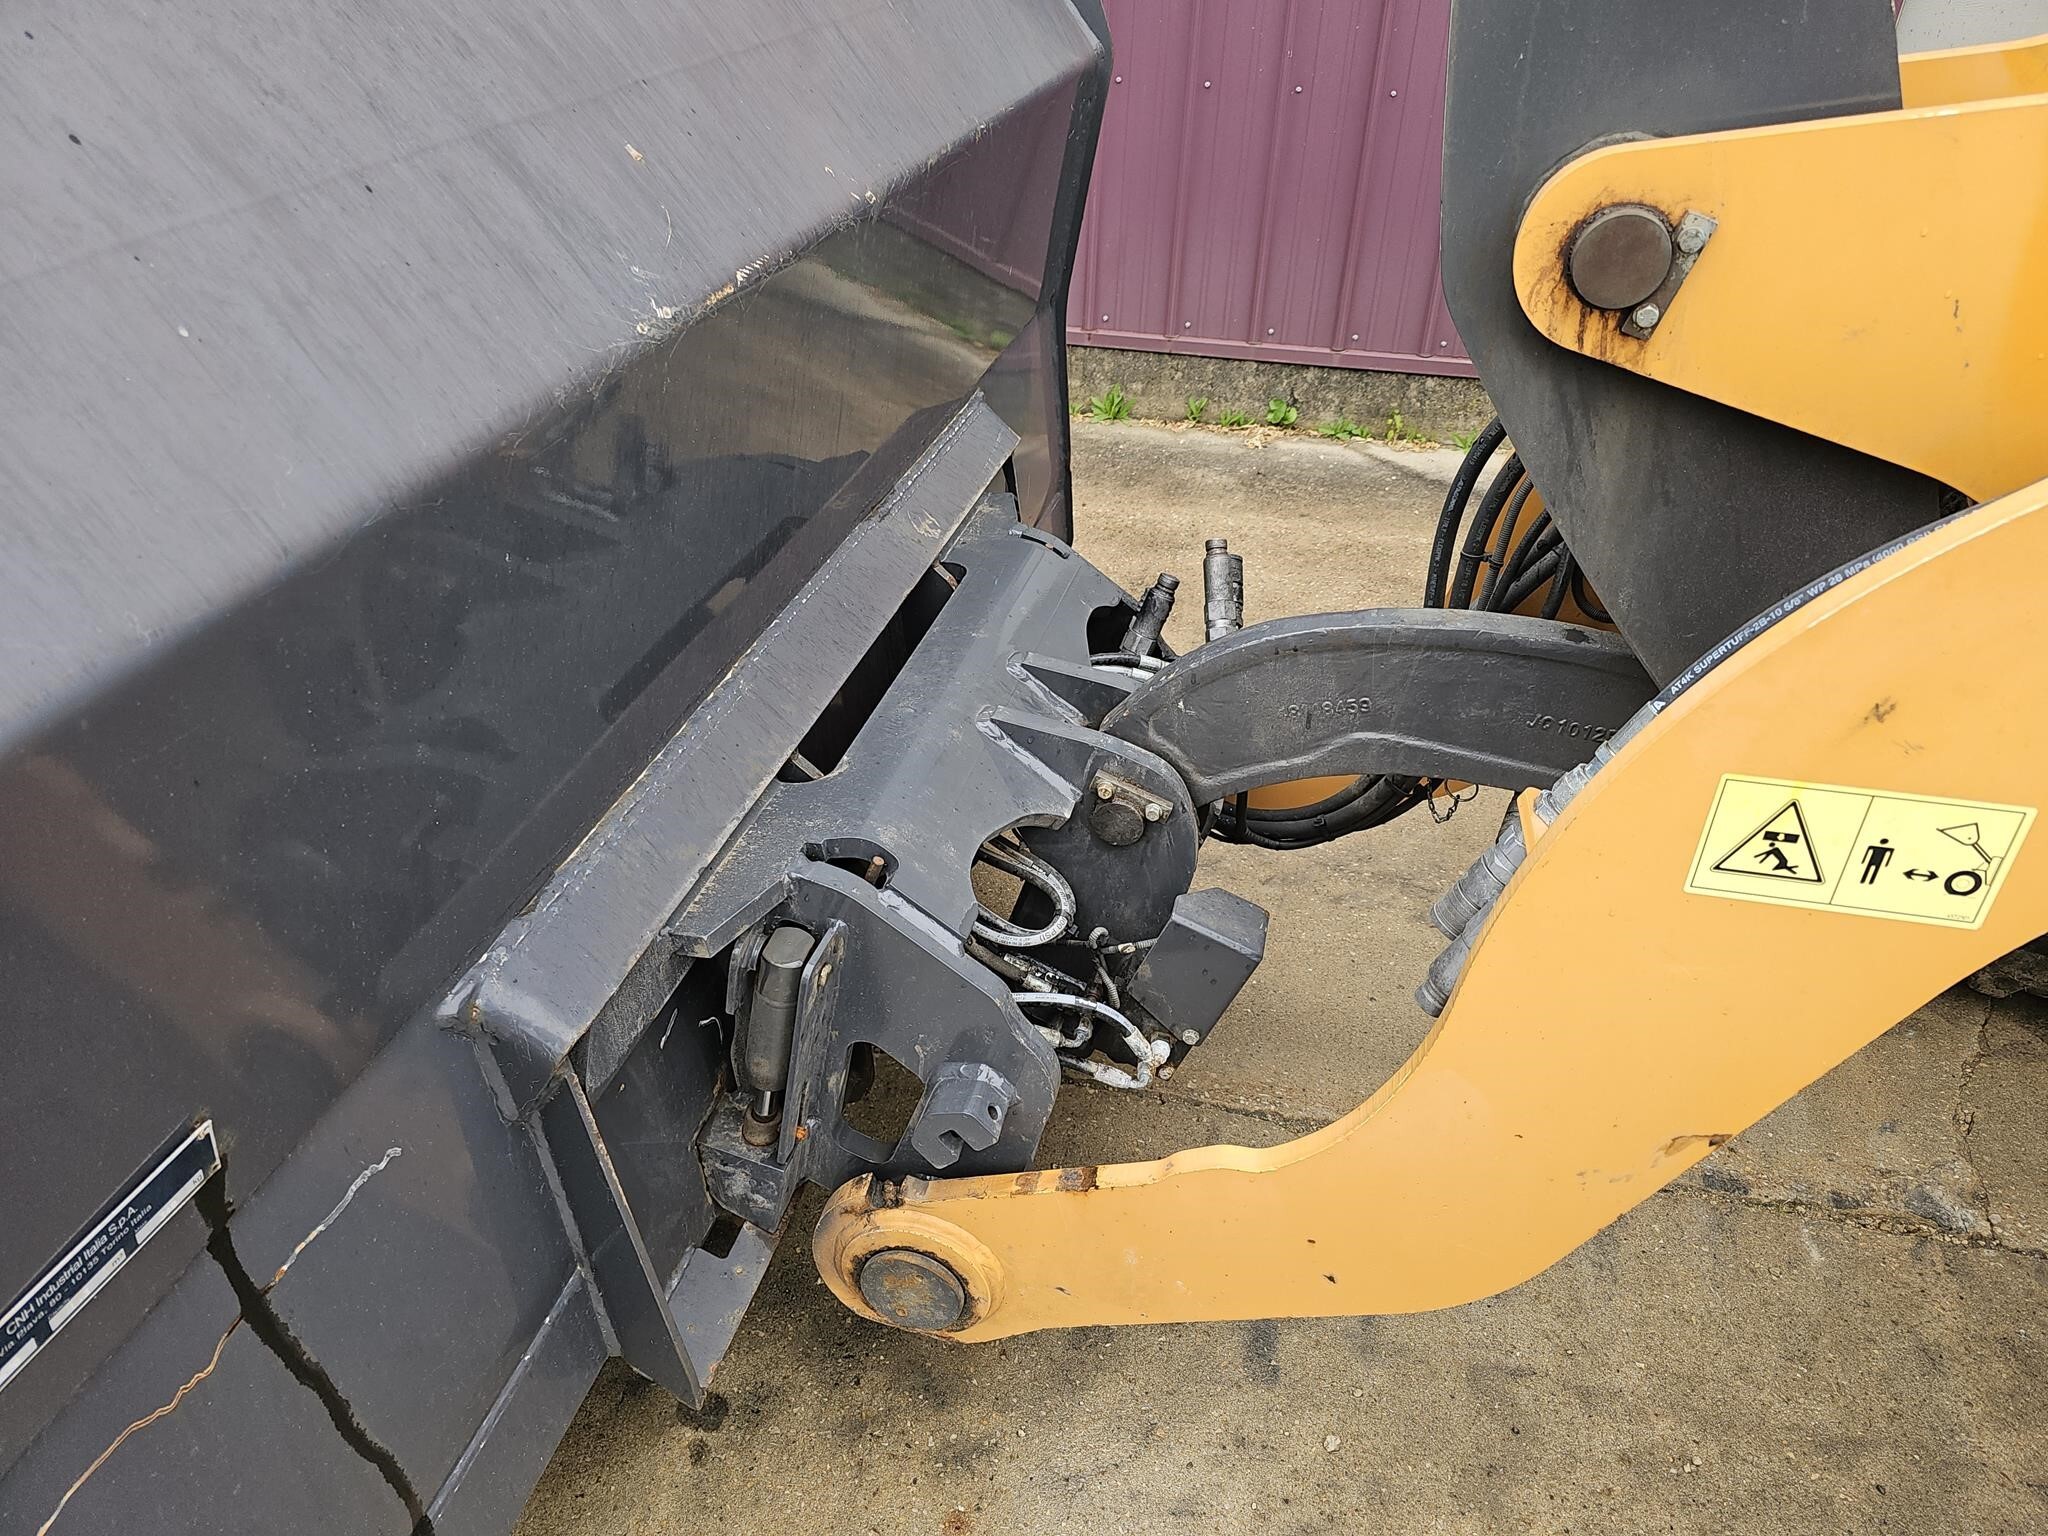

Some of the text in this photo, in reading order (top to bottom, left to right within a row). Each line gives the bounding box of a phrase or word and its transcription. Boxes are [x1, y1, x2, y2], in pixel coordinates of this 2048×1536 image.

[1670, 671, 1695, 695] AT4K
[1693, 608, 1783, 674] SUPERTUFF-2B-10
[1807, 582, 1826, 597] WP
[1828, 573, 1843, 586] 28
[6, 1303, 35, 1335] CNH
[35, 1256, 83, 1307] Industrial
[83, 1234, 108, 1260] Italia
[108, 1206, 138, 1236] S.p.A.
[71, 1255, 99, 1285] 10135
[101, 1227, 130, 1255] Torino
[130, 1204, 152, 1227] Italia
